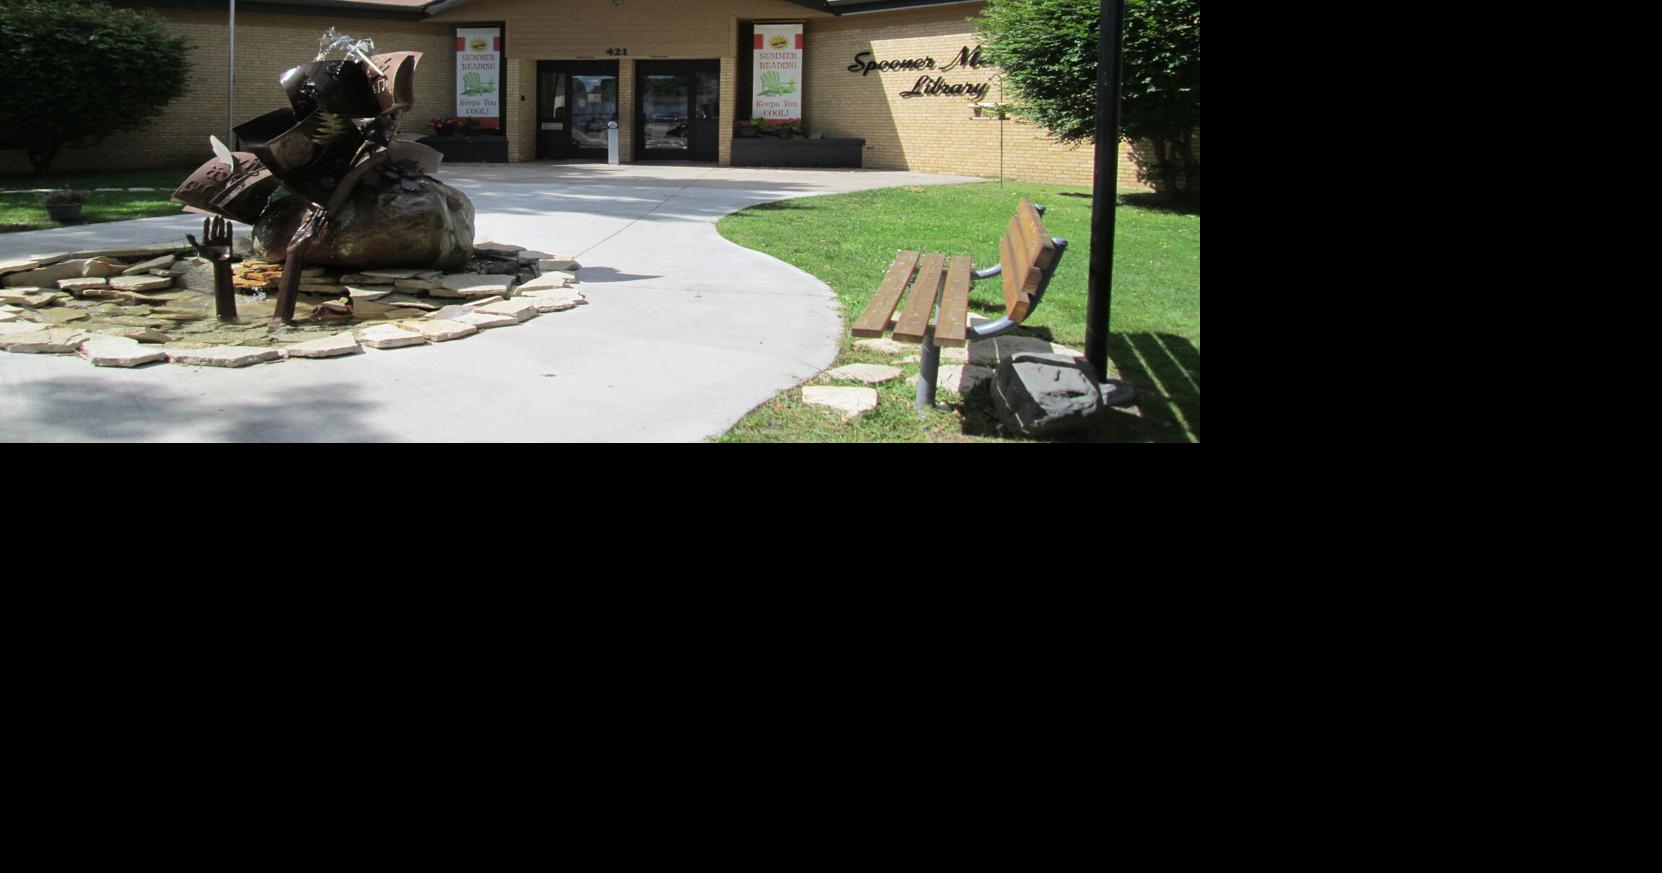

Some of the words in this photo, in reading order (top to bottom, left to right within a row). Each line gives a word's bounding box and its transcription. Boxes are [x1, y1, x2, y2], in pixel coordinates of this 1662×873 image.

[605, 47, 628, 57] 421
[760, 51, 798, 61] SUMMER
[462, 54, 496, 62] SUMMER
[462, 63, 496, 71] READING
[760, 61, 797, 70] READING
[847, 51, 936, 77] Spooner
[899, 74, 989, 99] Library
[483, 99, 498, 107] You
[755, 100, 779, 109] Keeps
[783, 100, 799, 108] You
